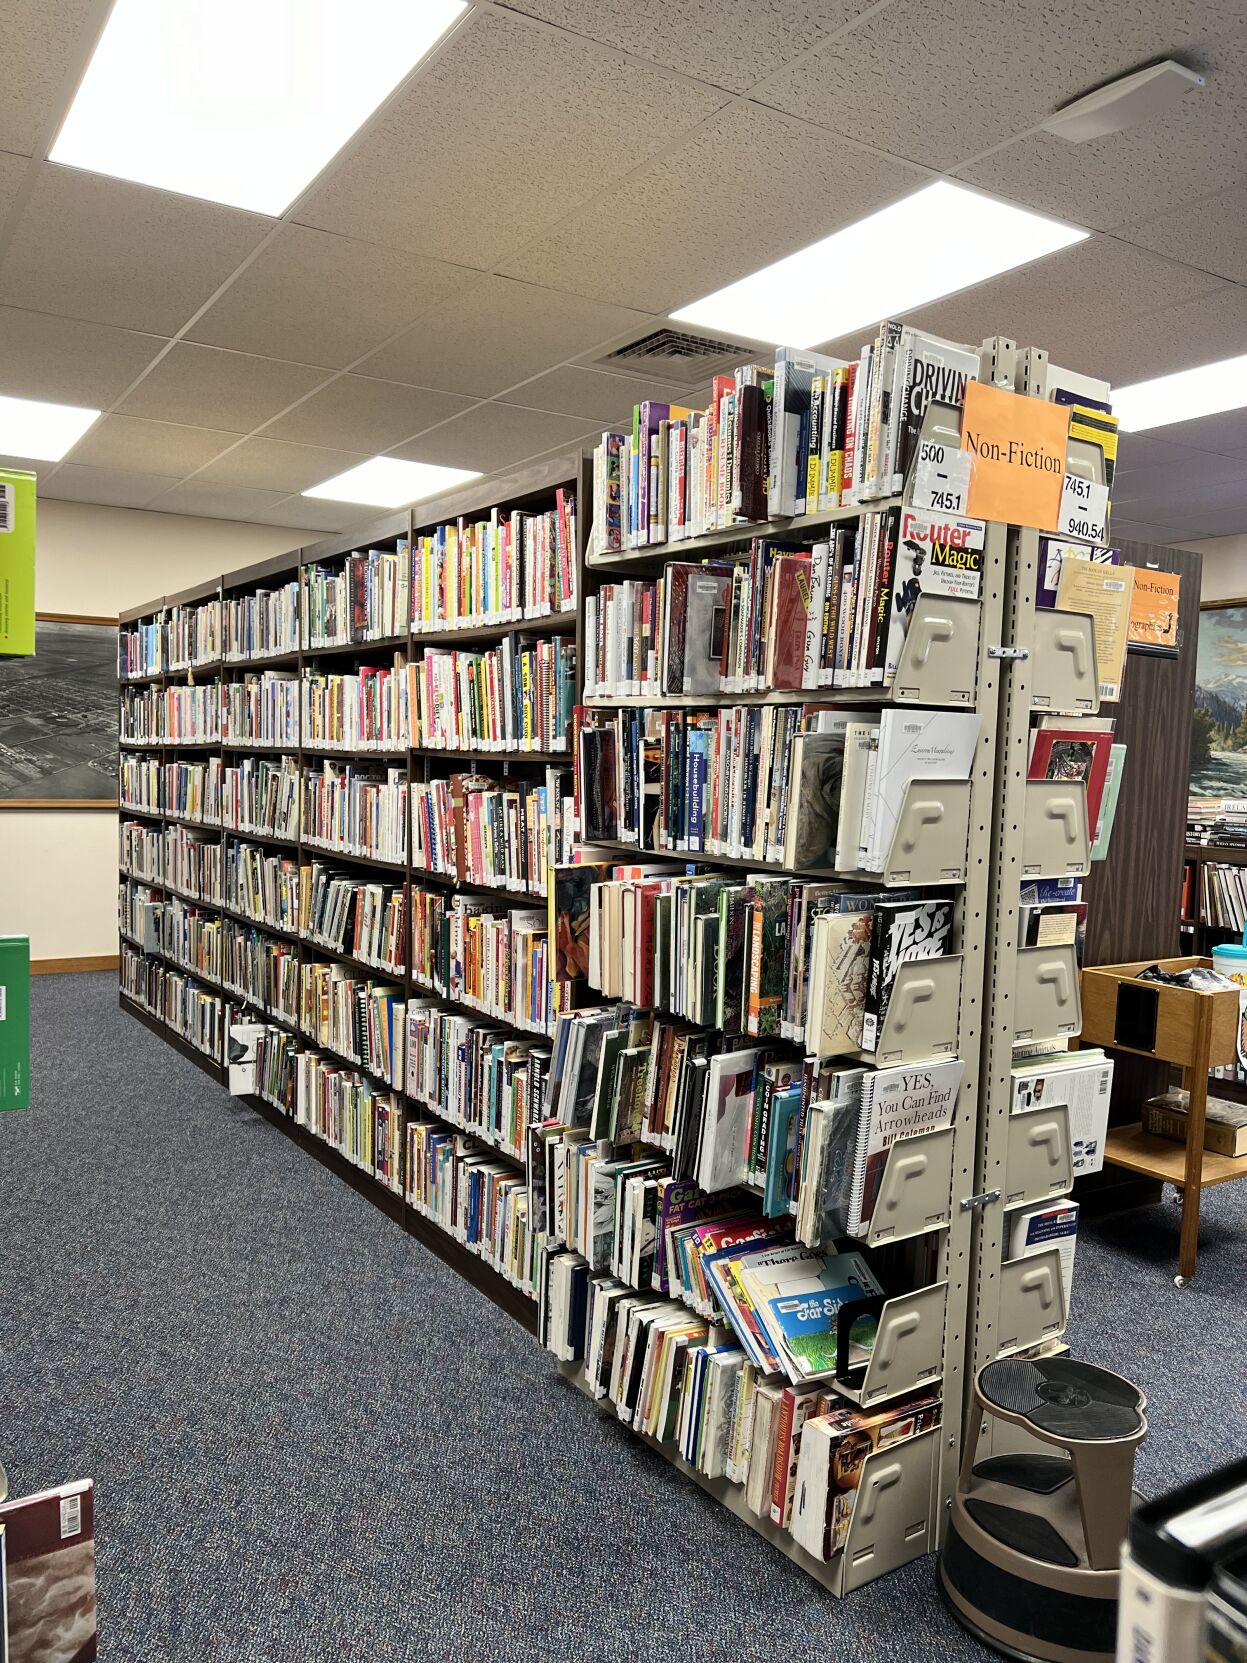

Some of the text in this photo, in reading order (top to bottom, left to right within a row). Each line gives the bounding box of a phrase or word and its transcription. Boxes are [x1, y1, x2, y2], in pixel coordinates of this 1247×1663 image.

[913, 358, 976, 407] DRIVIN
[900, 386, 910, 422] CHANGE
[810, 400, 819, 449] Accounting
[846, 437, 854, 449] ON
[920, 443, 945, 464] 500
[966, 431, 1062, 474] Non-Fiction
[726, 460, 734, 502] Dummies
[808, 463, 816, 497] DUMMIE
[829, 459, 837, 492] DUMMIE
[844, 452, 853, 479] CHAOS
[718, 480, 726, 511] BOOK
[930, 490, 961, 511] 745.1
[1064, 475, 1091, 500] 745.1
[1068, 518, 1104, 542] 940.54
[882, 541, 894, 585] Router
[931, 539, 979, 573] Magic
[795, 572, 809, 602] LAUREL
[825, 566, 833, 598] RELOADING
[1134, 580, 1174, 595] Non-Fiction
[877, 588, 890, 623] Magic
[840, 608, 848, 635] WOOD
[804, 630, 815, 651] Gun
[803, 654, 815, 673] Guy
[691, 753, 700, 823] Housebuilding
[750, 927, 760, 993] LANDSCAPING
[532, 1058, 541, 1124] ARNOLD SCHWARZ
[902, 1073, 934, 1091] YES,
[878, 1087, 952, 1117] You Can Find
[759, 1085, 771, 1152] COIN GRADING
[874, 1104, 948, 1135] Arrowheads
[669, 1199, 705, 1214] FAT CAT
[823, 1298, 847, 1316] Sid
[779, 1405, 791, 1439] ANTIQUES
[775, 1440, 786, 1479] ROADSHOW
